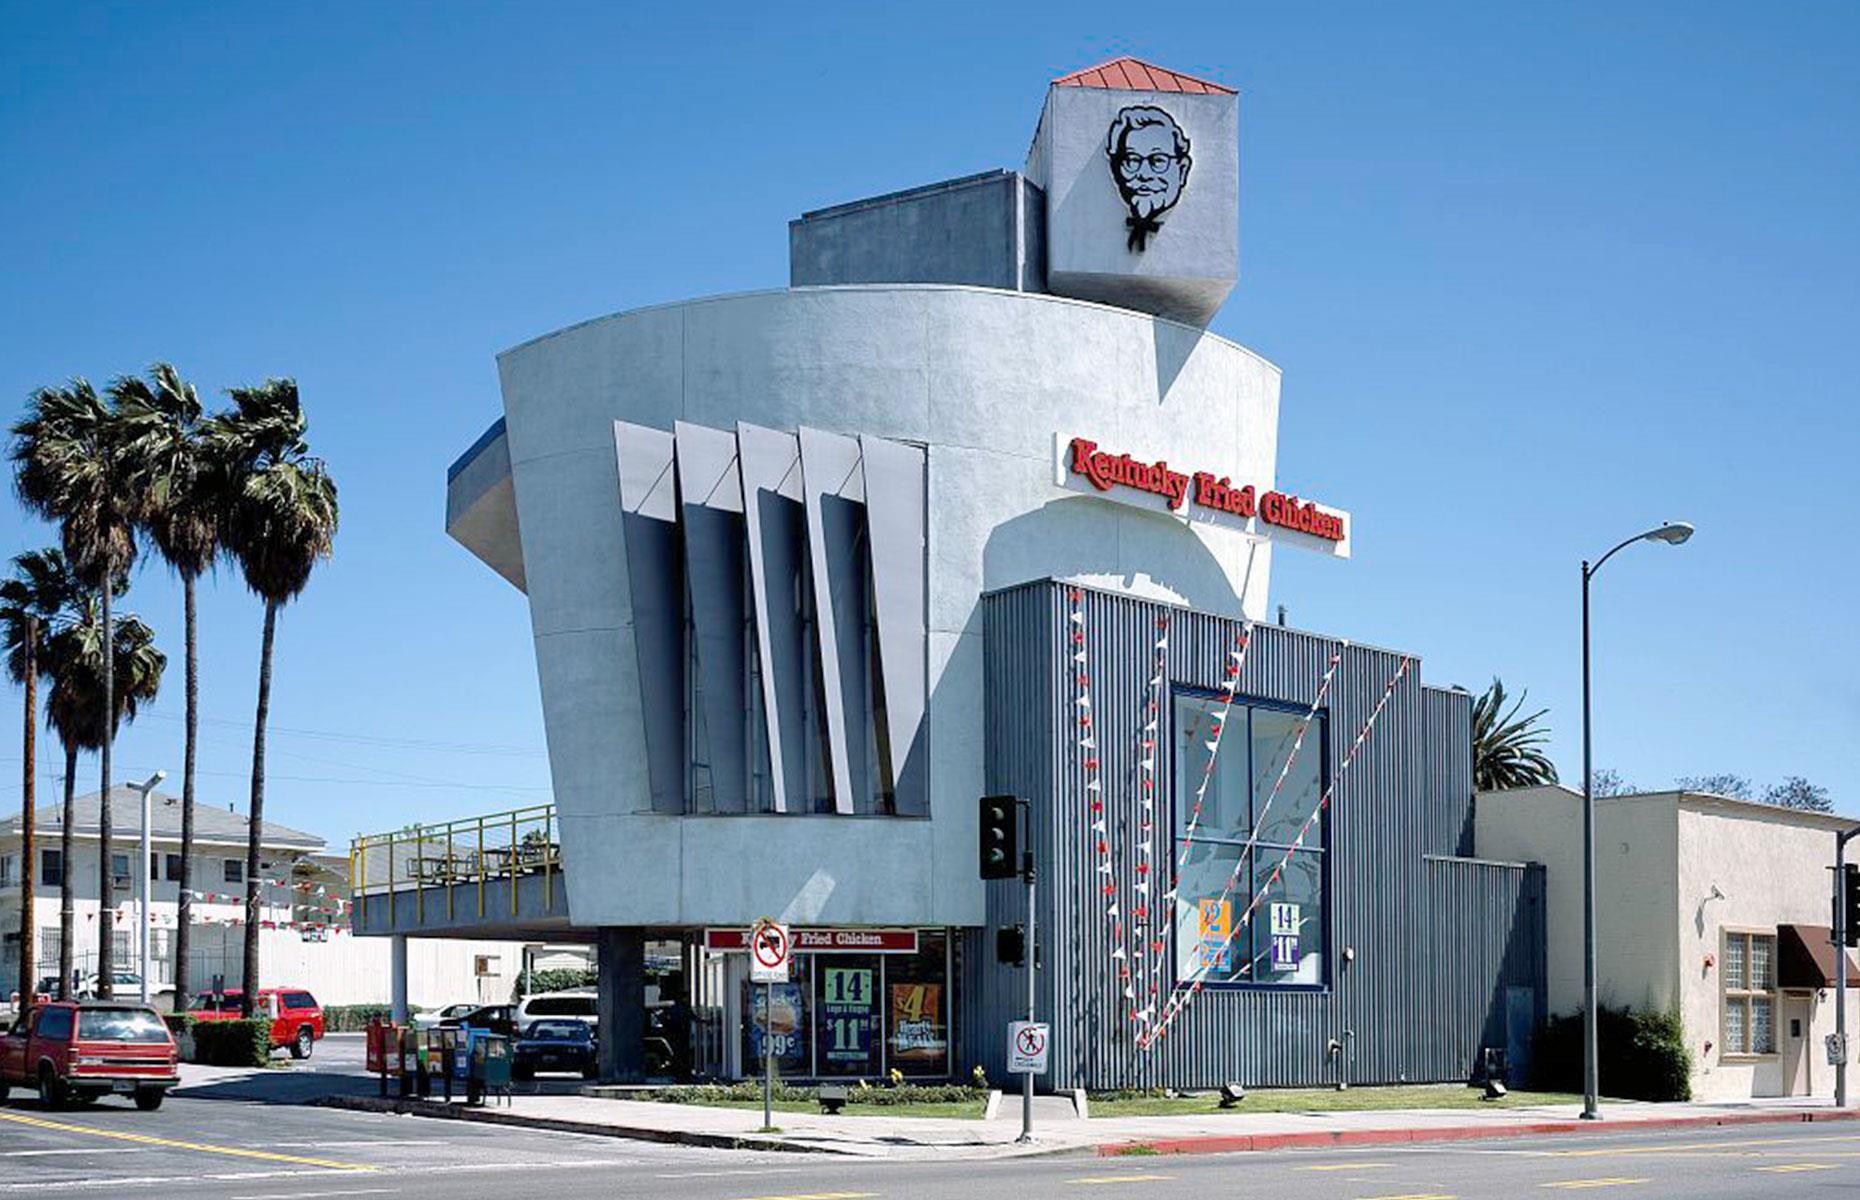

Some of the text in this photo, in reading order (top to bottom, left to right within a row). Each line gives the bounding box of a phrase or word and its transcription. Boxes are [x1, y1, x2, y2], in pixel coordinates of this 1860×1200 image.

[1070, 437, 1345, 541] Kentucky Fried Chicken
[1278, 905, 1292, 929] 14
[801, 932, 832, 945] Fried
[836, 932, 882, 945] Chicken
[835, 971, 863, 1001] 14
